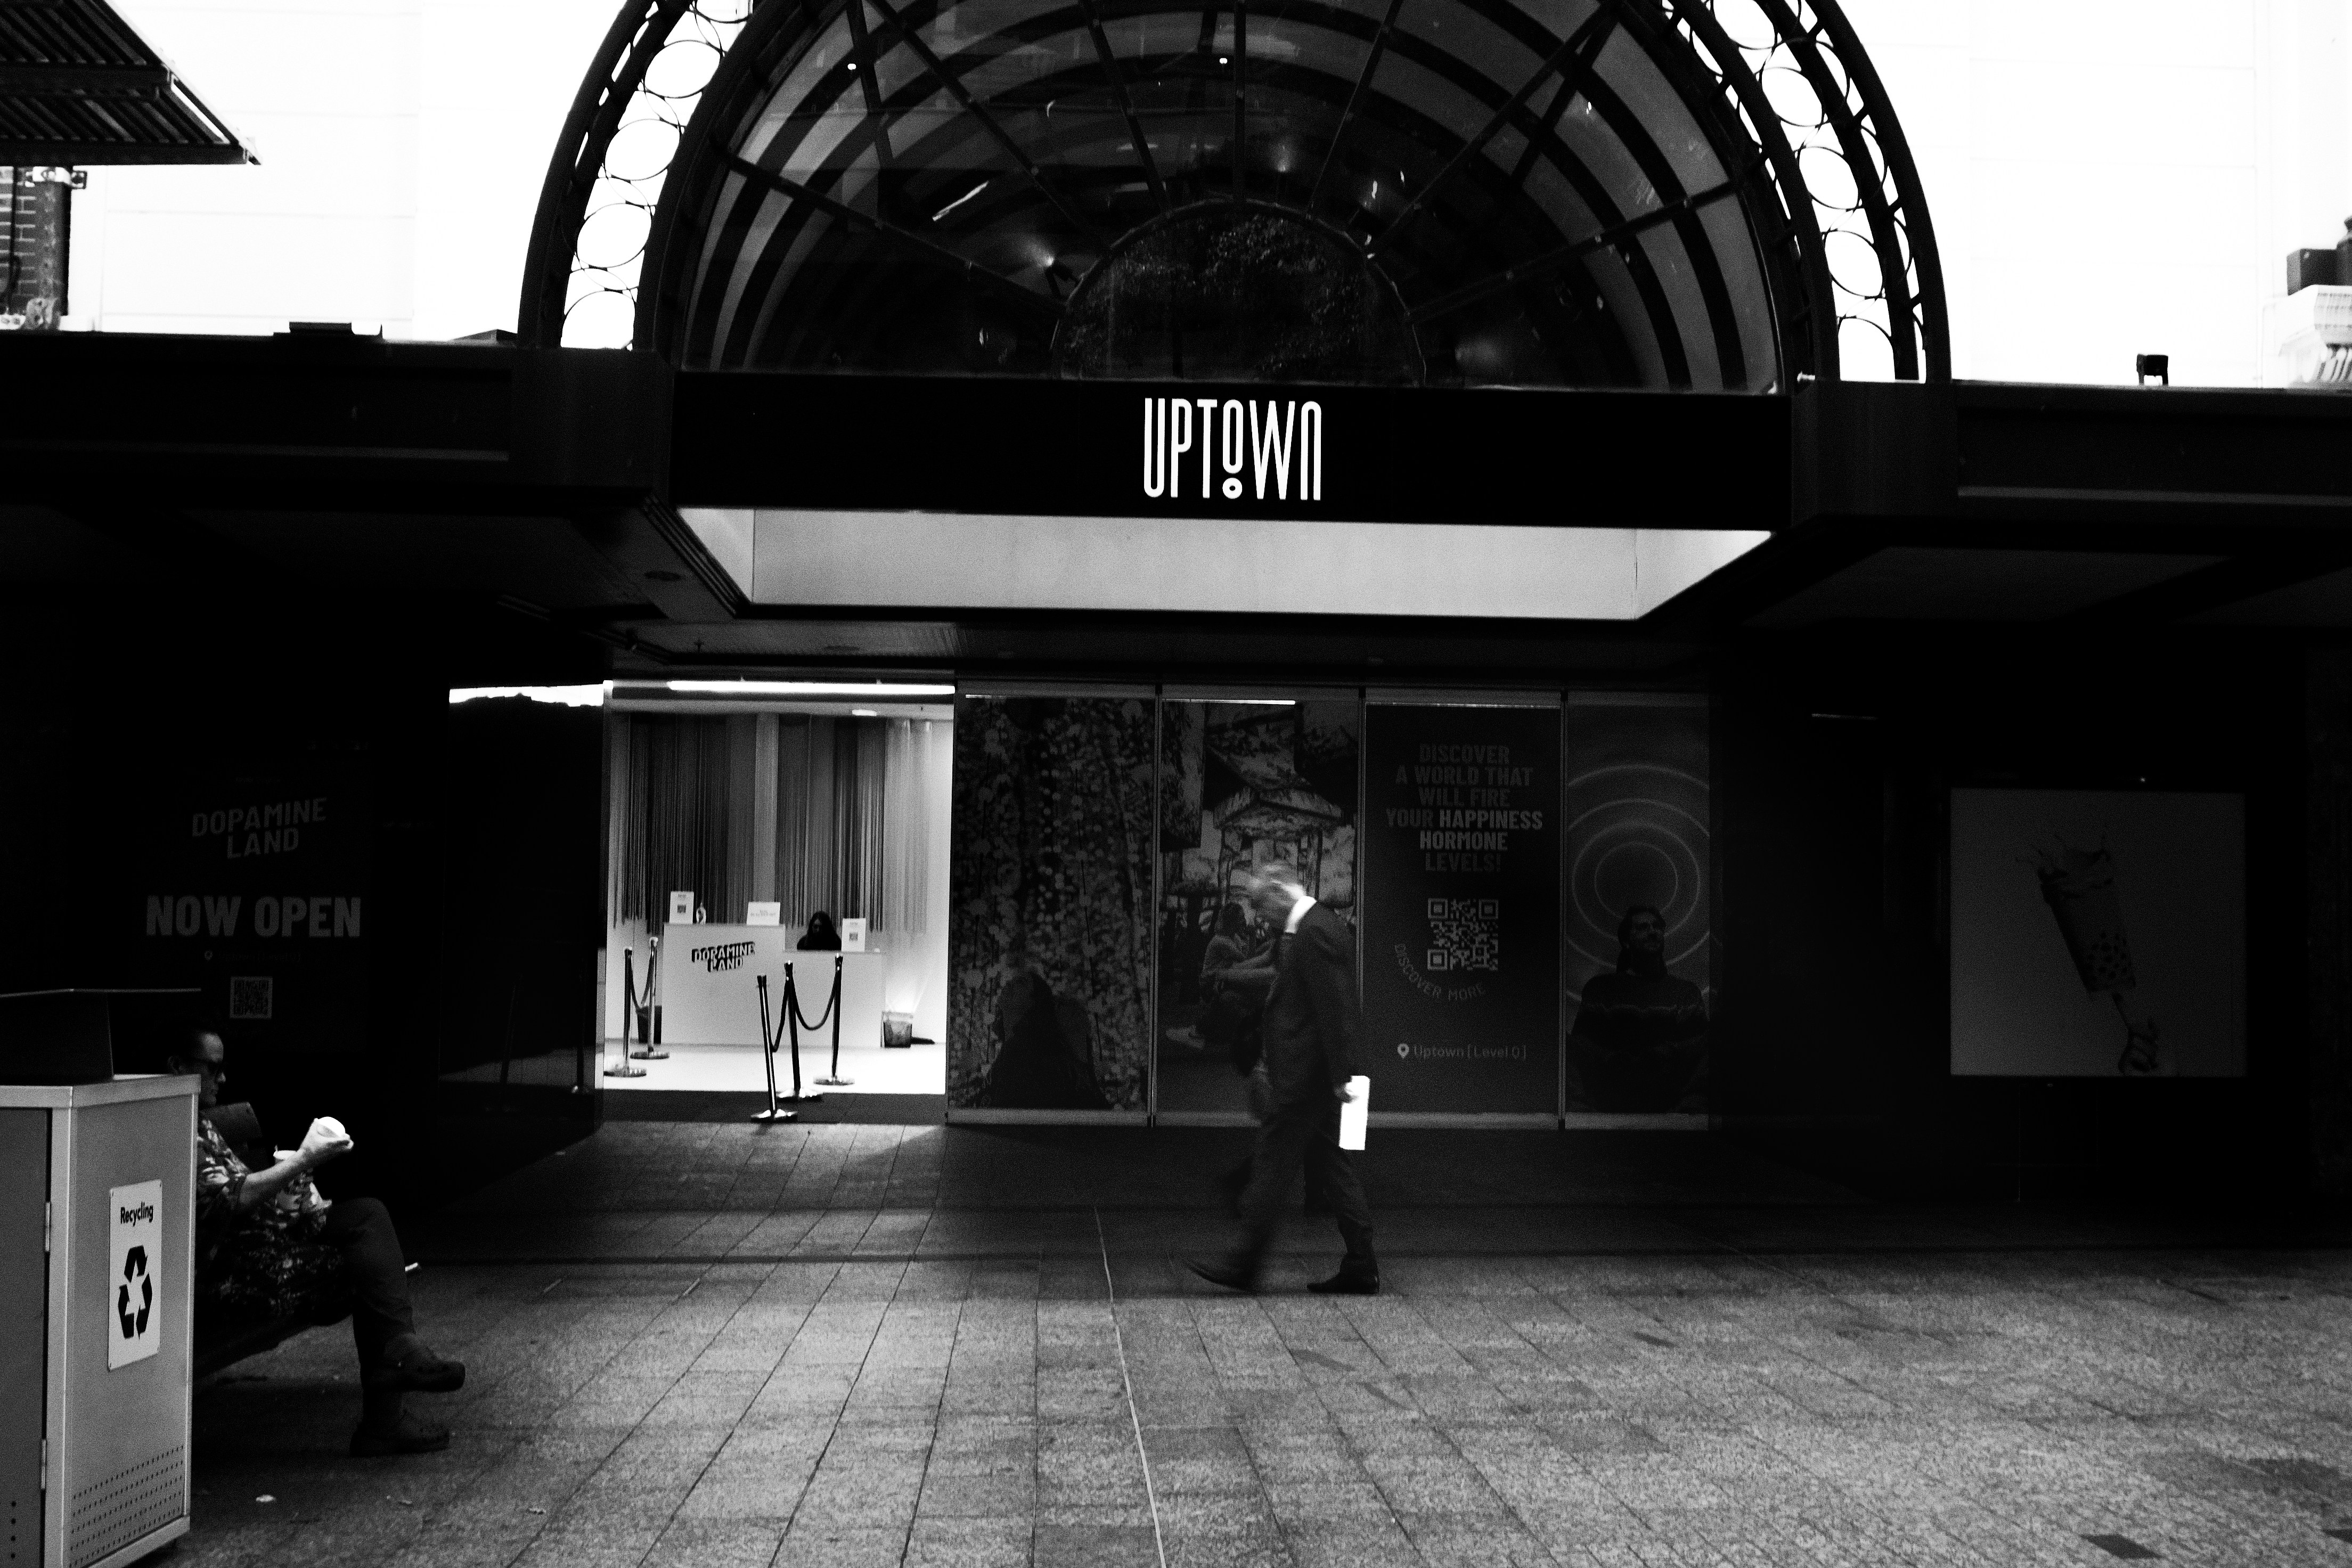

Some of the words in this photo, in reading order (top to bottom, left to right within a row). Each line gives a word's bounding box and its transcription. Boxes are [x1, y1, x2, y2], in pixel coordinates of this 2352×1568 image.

[1144, 398, 1321, 501] UPTOWN
[1419, 744, 1510, 764] DISCOVER
[1395, 765, 1408, 785] A
[1414, 766, 1480, 785] WORLD
[1484, 766, 1534, 787] THAT
[1418, 786, 1465, 807] WILL
[1470, 788, 1510, 808] FIRE
[192, 797, 327, 837] DOPAMINE
[1386, 807, 1434, 828] YOUR
[1439, 809, 1544, 830] HAPPINESS
[226, 827, 300, 859] LAND
[1419, 830, 1508, 852] HORMONE
[1425, 853, 1501, 872] LEVELS!
[146, 895, 241, 936] NOW
[254, 896, 361, 937] OPEN
[692, 941, 755, 962] DOPAMINE
[707, 957, 743, 973] LAND
[1394, 943, 1442, 998] DISCOVER
[1448, 982, 1486, 1001] MORE
[1413, 1044, 1464, 1060] Uptown
[120, 1202, 153, 1227] Recycling
